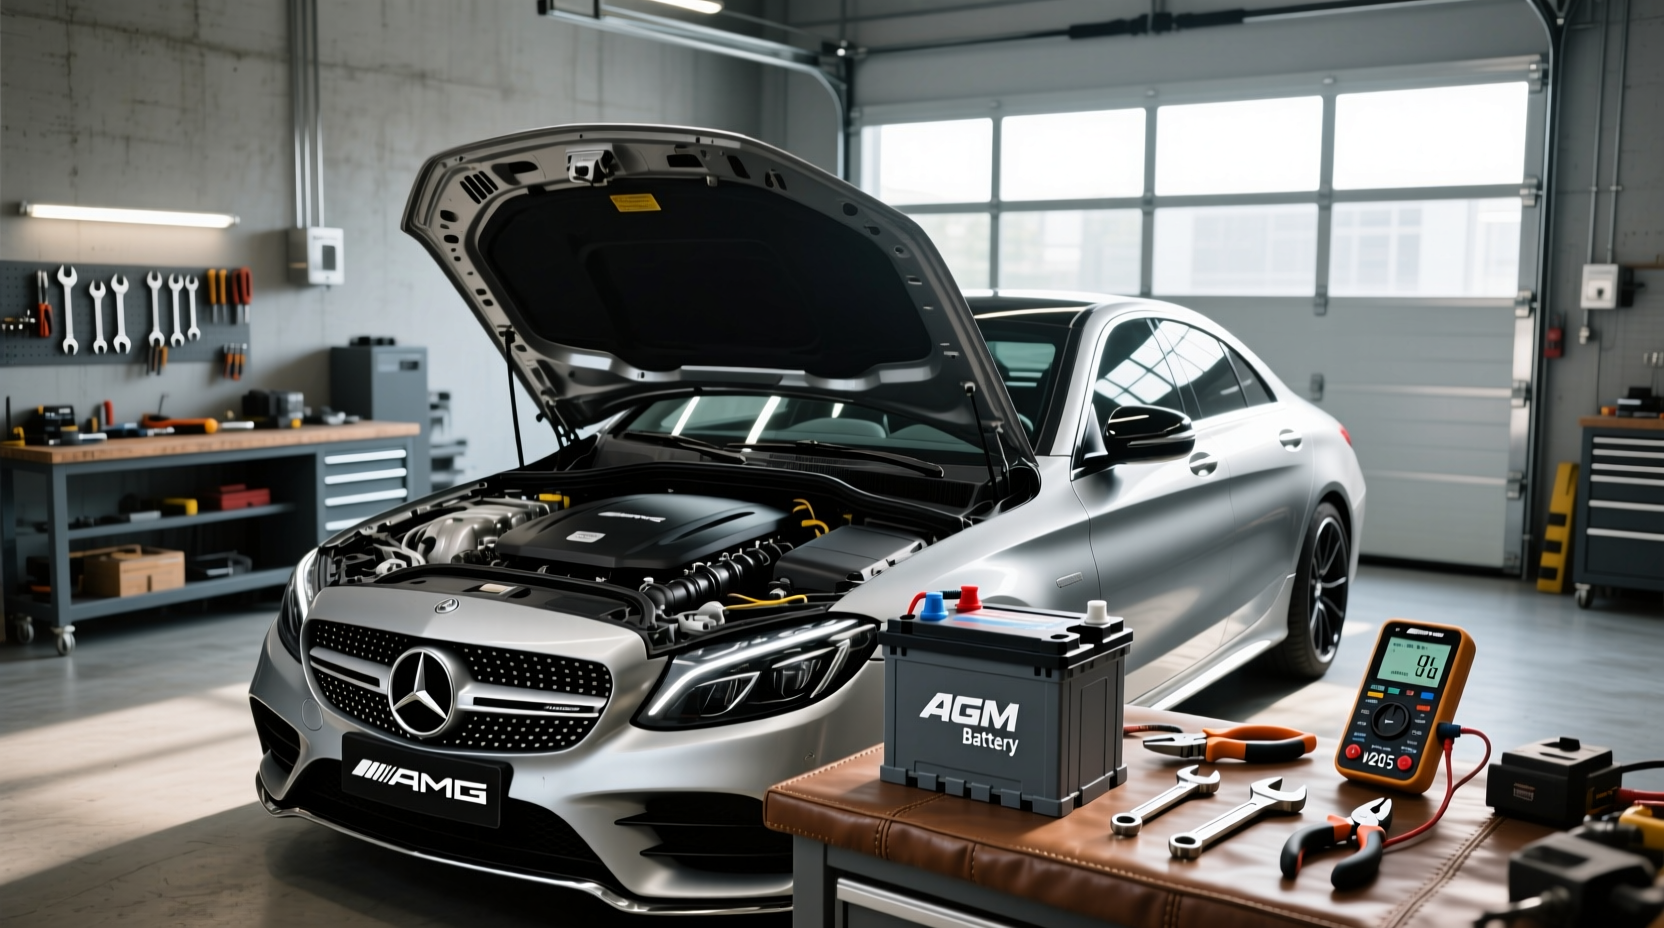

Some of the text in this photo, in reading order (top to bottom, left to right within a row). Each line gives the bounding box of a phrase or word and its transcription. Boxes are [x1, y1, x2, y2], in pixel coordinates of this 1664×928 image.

[919, 692, 1020, 732] AGM
[962, 727, 1019, 757] Battery
[388, 767, 487, 805] AMG
